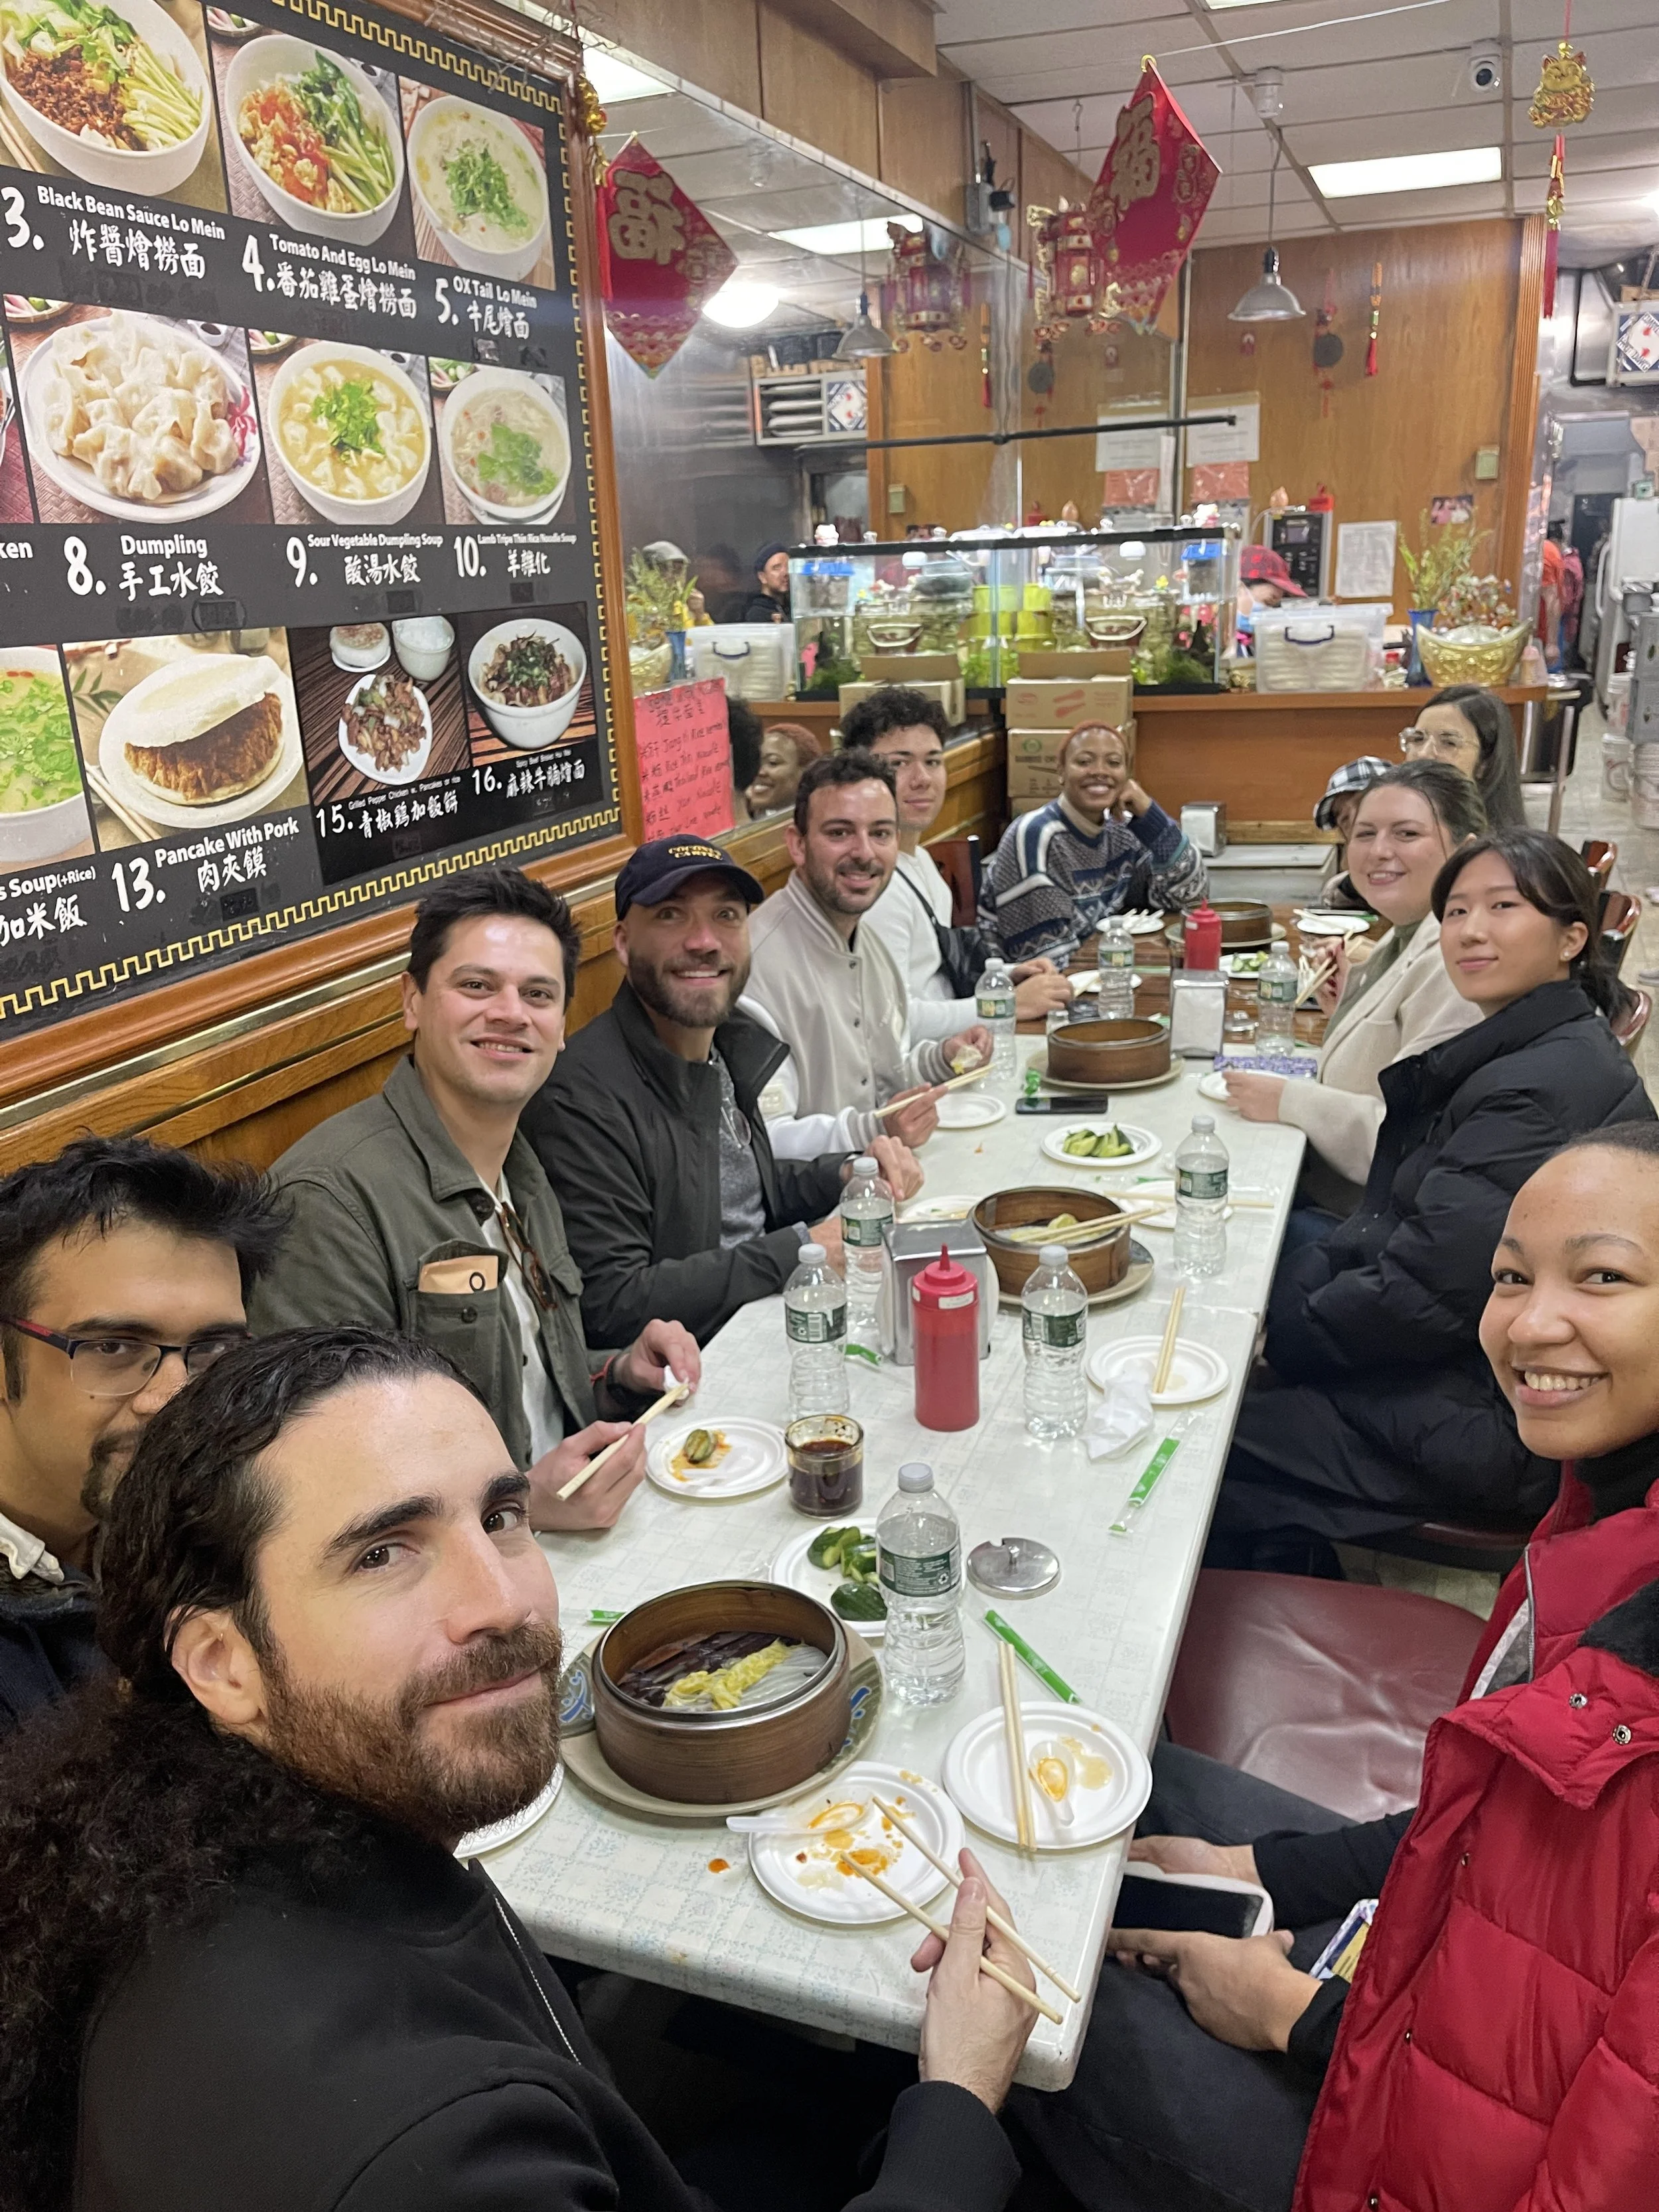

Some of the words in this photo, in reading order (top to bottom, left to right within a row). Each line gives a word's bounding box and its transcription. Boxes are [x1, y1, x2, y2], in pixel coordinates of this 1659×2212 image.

[1, 186, 44, 250] 3.
[38, 185, 84, 211] Black
[85, 195, 125, 220] Bean
[127, 204, 169, 228] Sauce
[172, 214, 190, 232] Lo
[192, 218, 225, 240] Mein
[242, 235, 275, 292] 4.
[269, 234, 319, 260] Tomato
[322, 248, 347, 267] And
[348, 252, 371, 274] Egg
[372, 258, 388, 273] Lo
[388, 260, 416, 281] Mein
[435, 277, 459, 325] 5.
[470, 279, 493, 299] Tail
[496, 283, 510, 303] Lo
[120, 534, 208, 559] Dumpling
[286, 536, 317, 587] 9.
[307, 534, 330, 547] Sour
[331, 533, 378, 550] Vegetable
[378, 533, 421, 548] Dumpling
[421, 533, 444, 548] Soup
[453, 536, 486, 577] 10.
[64, 536, 106, 596] 8.
[119, 561, 224, 601] 手工水餃
[344, 553, 421, 585] 酸湯水餃
[472, 766, 502, 796] 16.
[155, 838, 225, 868] Pancake
[225, 824, 263, 850] With
[264, 816, 299, 842] Pork
[316, 804, 353, 838] 15.
[111, 857, 166, 913] 13.
[197, 845, 267, 893] 肉夾饃
